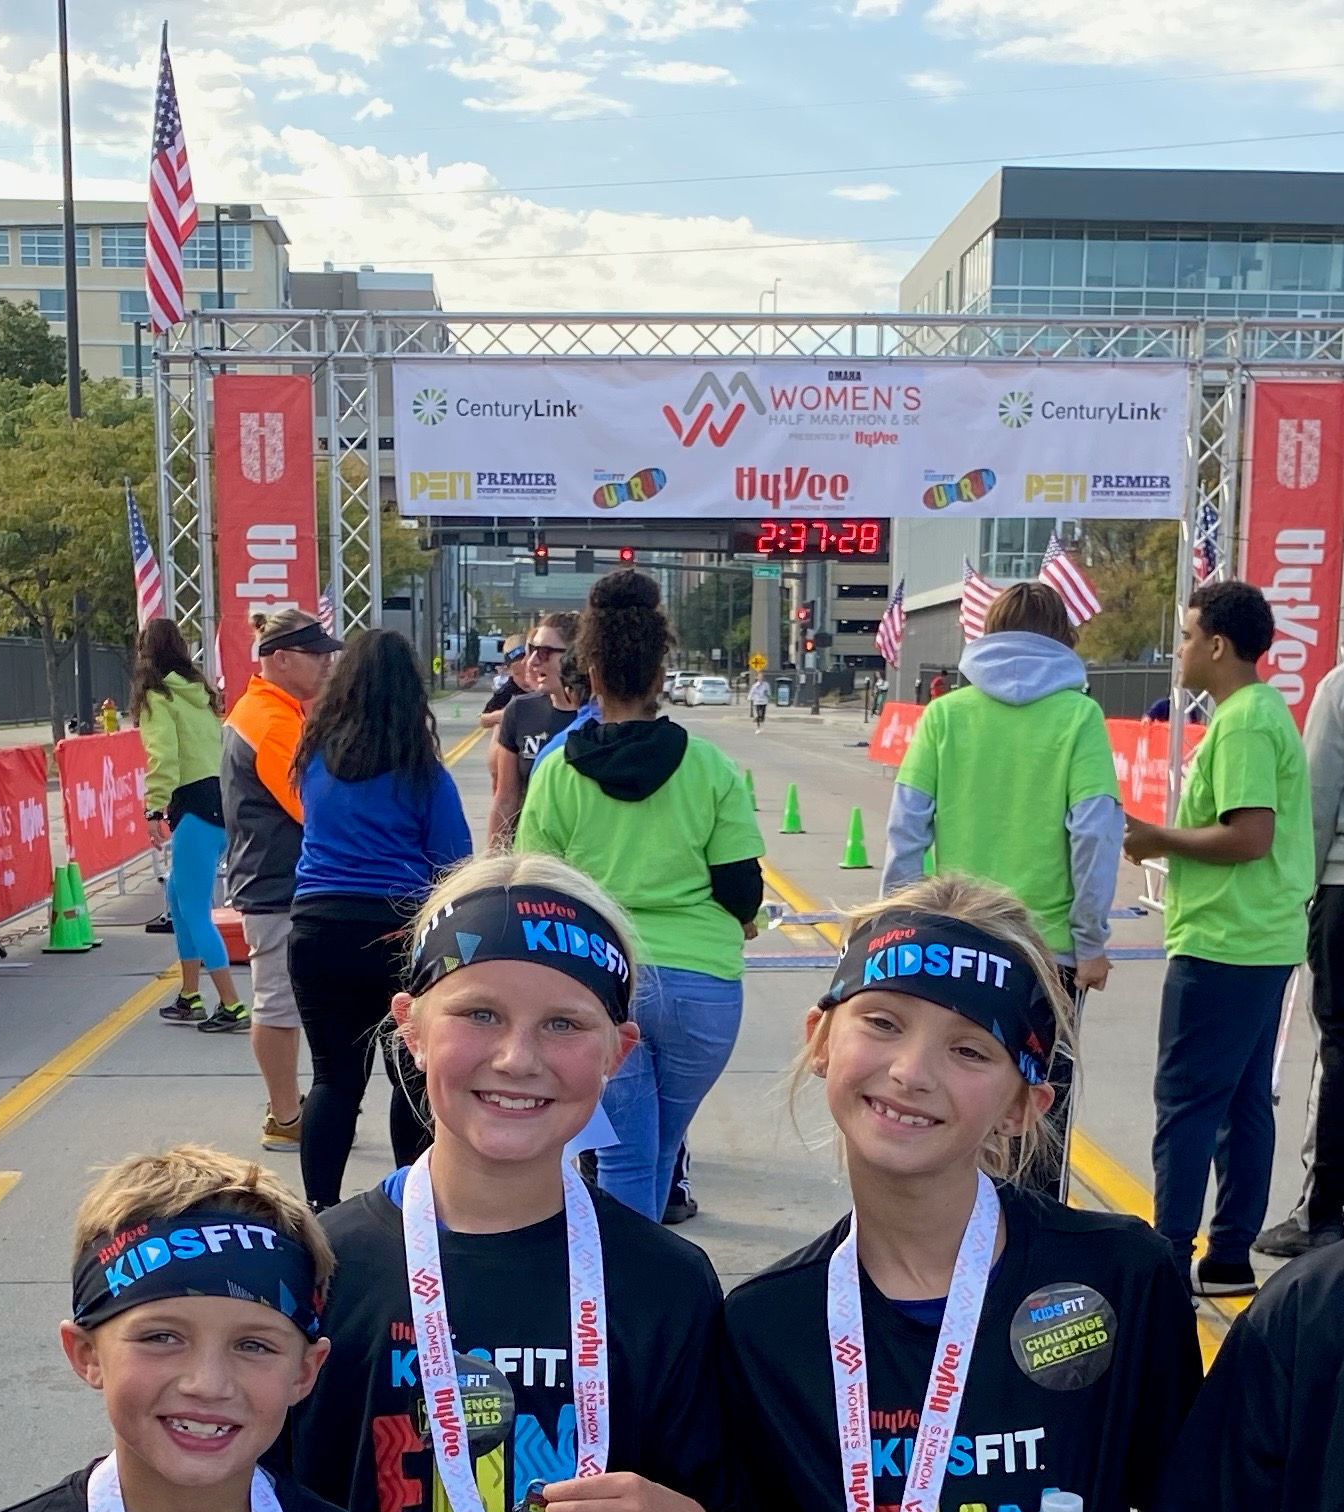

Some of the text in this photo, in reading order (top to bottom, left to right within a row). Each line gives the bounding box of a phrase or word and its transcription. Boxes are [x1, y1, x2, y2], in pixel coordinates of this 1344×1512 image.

[828, 370, 861, 381] OMAHA
[456, 398, 577, 421] CenturyLink
[769, 414, 920, 426] HALF MARATHON & 5K
[770, 386, 921, 411] WOMEN'S
[1042, 401, 1161, 424] CenturyLink
[476, 472, 556, 486] PREMIER
[735, 467, 849, 510] HyVee
[1092, 475, 1171, 489] PREMIER
[522, 920, 629, 983] KIDSFIT
[863, 943, 1012, 988] KIDSFIT
[105, 1224, 277, 1298] KIDSFIT
[1029, 1297, 1085, 1323] KIDSFIT
[424, 1313, 444, 1376] WOMEN'S
[578, 1301, 602, 1367] HyVee
[1026, 1316, 1105, 1352] CHALLENGE
[1033, 1331, 1108, 1367] ACCEPTED
[928, 1343, 962, 1413] HyVee
[433, 1388, 461, 1457] HyVee
[586, 1380, 599, 1445] WOMEN'S
[847, 1383, 861, 1450] WOMEN'S
[917, 1425, 942, 1490] WOMEN'S
